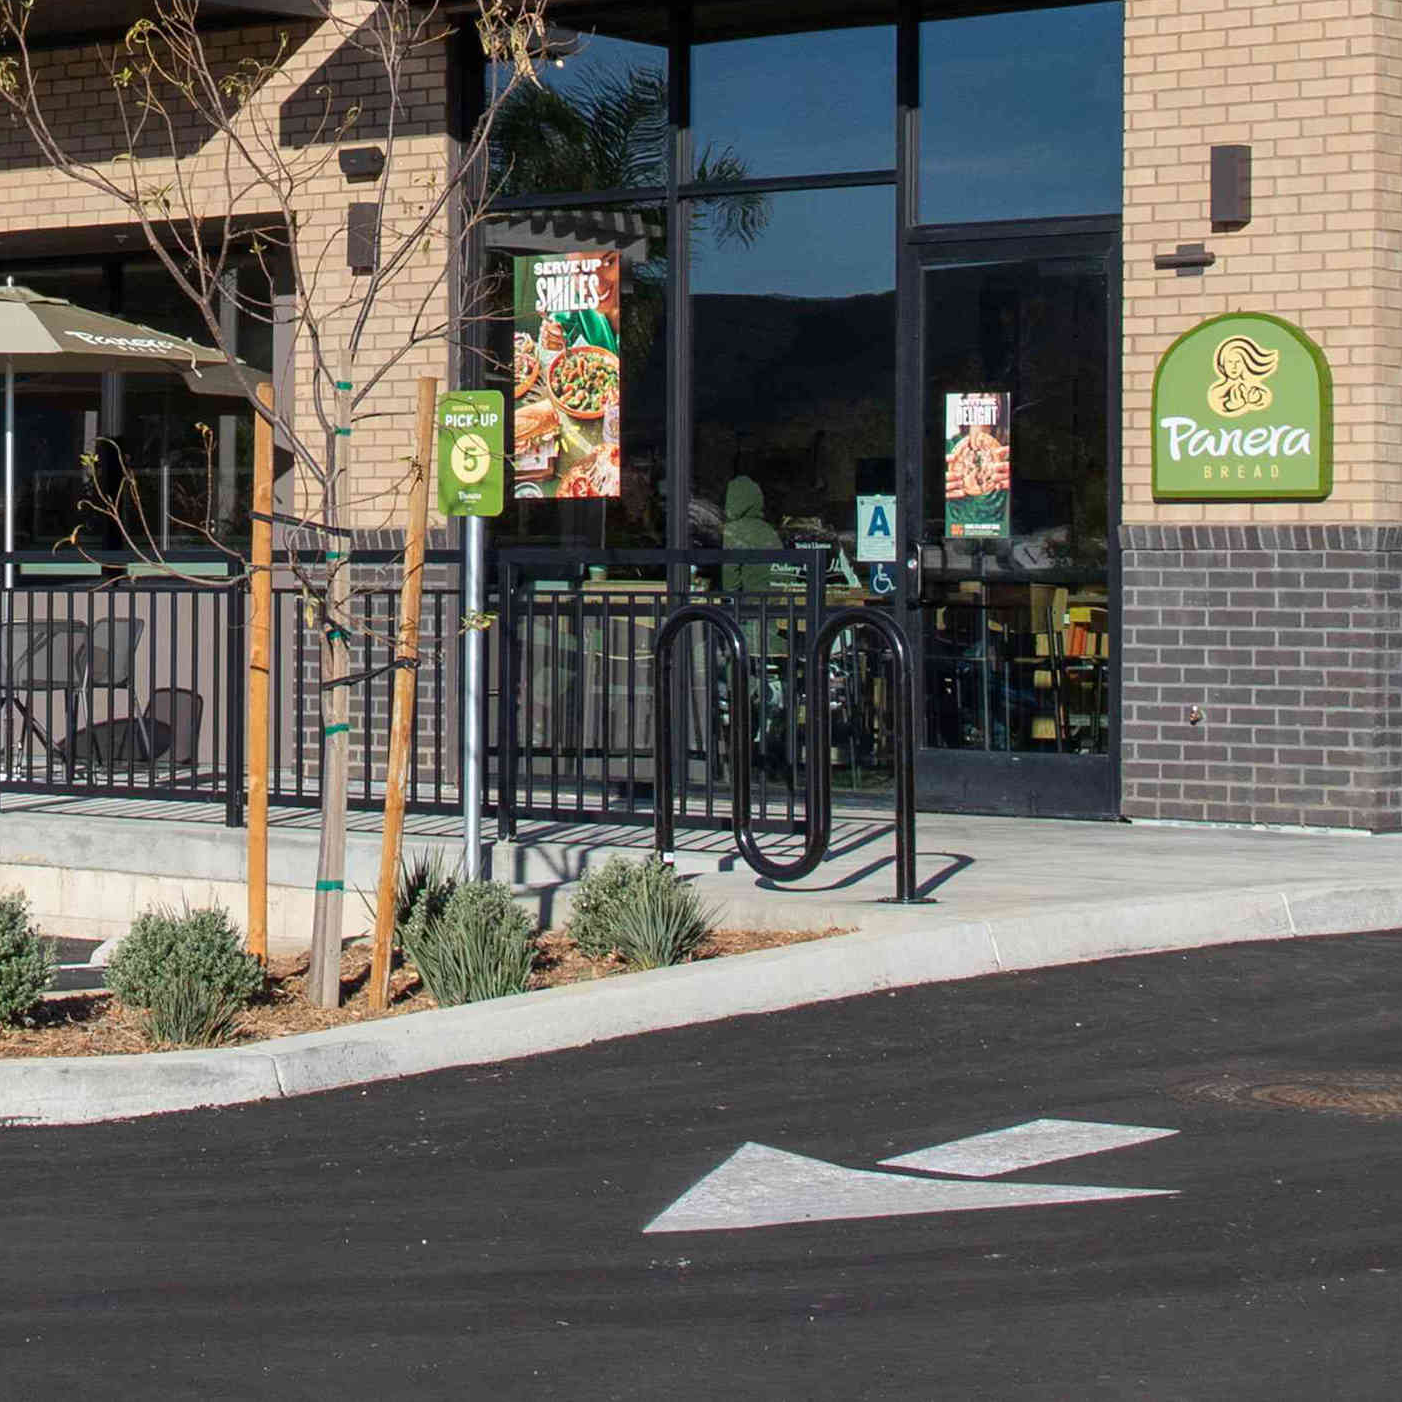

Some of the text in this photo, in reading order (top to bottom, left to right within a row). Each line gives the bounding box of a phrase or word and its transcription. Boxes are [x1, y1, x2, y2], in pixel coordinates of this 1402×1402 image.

[533, 258, 602, 276] SERVE UP
[534, 273, 601, 312] SMILES
[445, 413, 498, 428] PICK-UP
[1159, 415, 1312, 462] Panera
[463, 447, 478, 472] 5
[1203, 464, 1280, 479] BREAD
[867, 505, 891, 536] A
